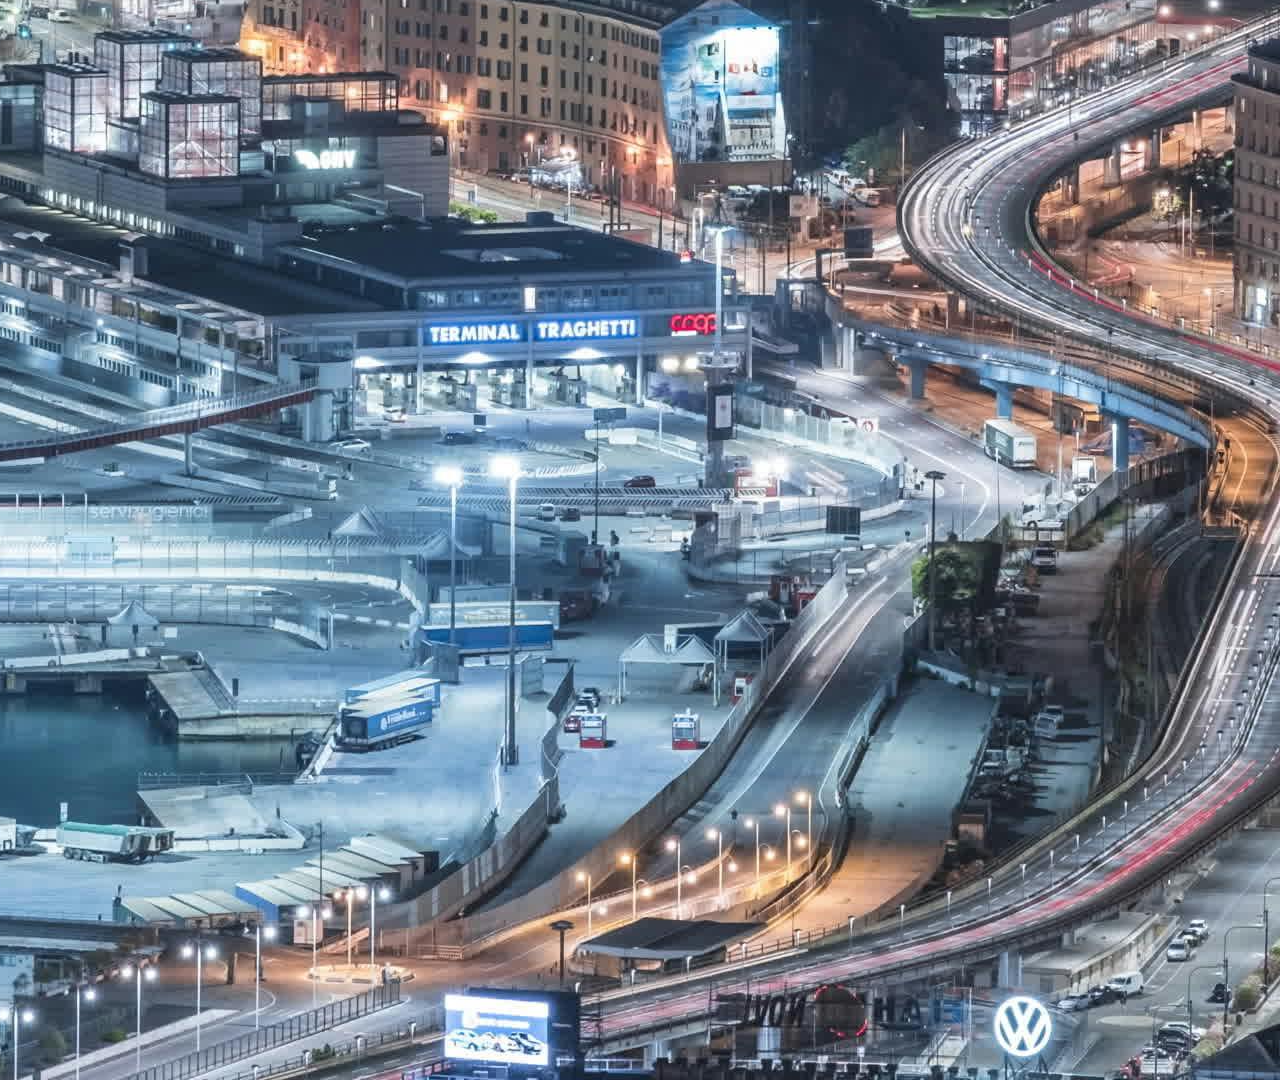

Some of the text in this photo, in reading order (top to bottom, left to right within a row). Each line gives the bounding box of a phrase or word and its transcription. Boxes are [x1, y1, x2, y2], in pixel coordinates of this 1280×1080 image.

[429, 319, 635, 343] TERMINAL TRAGHETTI
[671, 313, 718, 336] coop
[996, 998, 1050, 1054] VW
